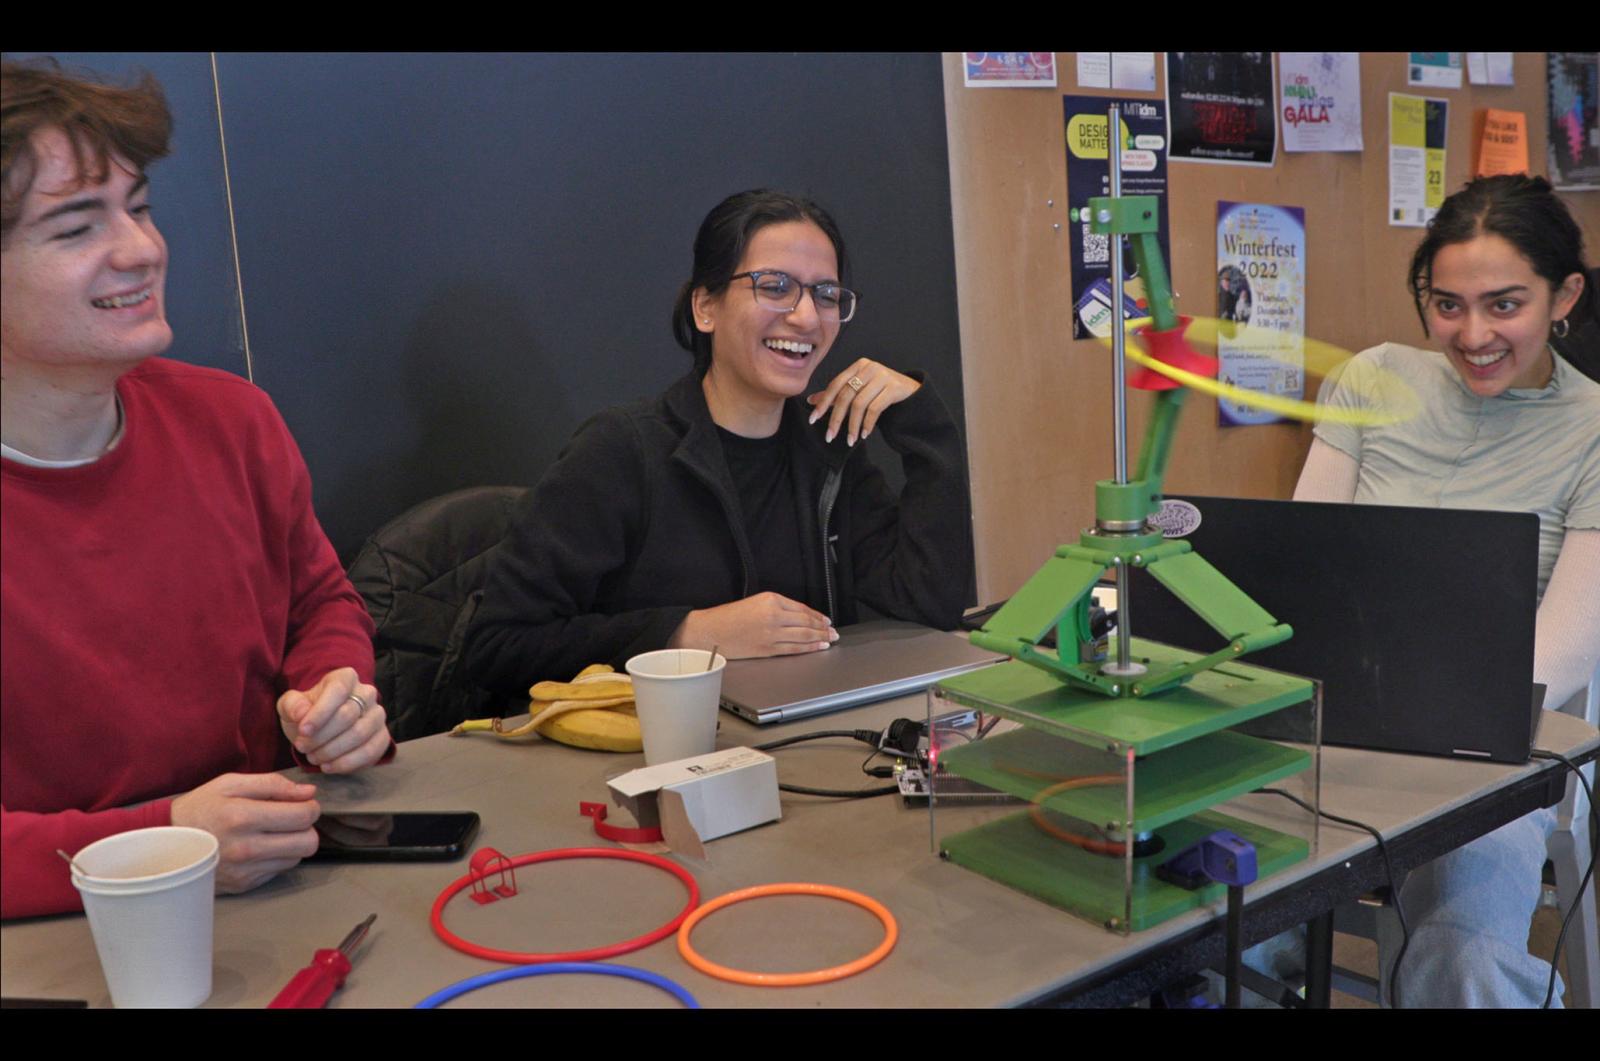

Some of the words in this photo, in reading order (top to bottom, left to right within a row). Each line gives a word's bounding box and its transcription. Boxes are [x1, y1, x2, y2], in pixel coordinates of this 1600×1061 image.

[1284, 106, 1330, 128] GALA
[1079, 123, 1109, 137] DESIG
[1079, 138, 1109, 150] MATTE
[1428, 170, 1441, 185] 23
[1224, 233, 1296, 258] Winterfest
[1239, 261, 1278, 279] 2022
[1256, 305, 1288, 316] December
